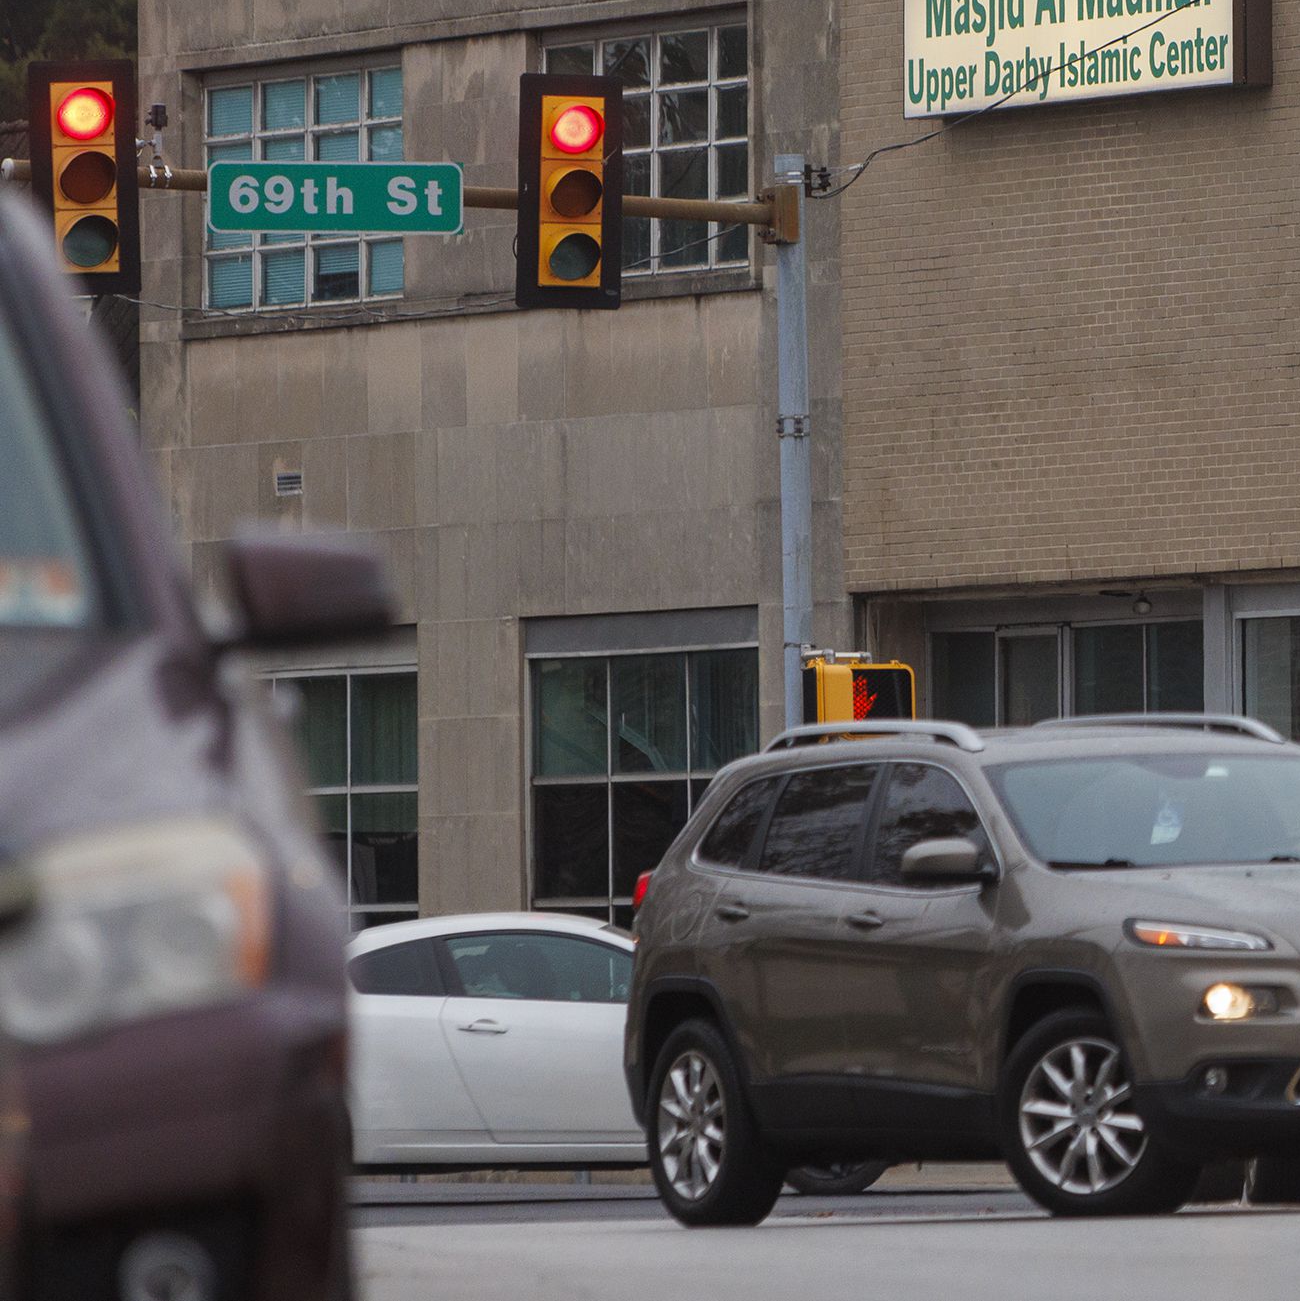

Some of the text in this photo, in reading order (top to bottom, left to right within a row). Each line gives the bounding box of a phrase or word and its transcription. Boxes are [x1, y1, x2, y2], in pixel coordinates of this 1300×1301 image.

[908, 27, 1229, 112] Upper Darby Islamic Center
[228, 174, 443, 216] 69th St
